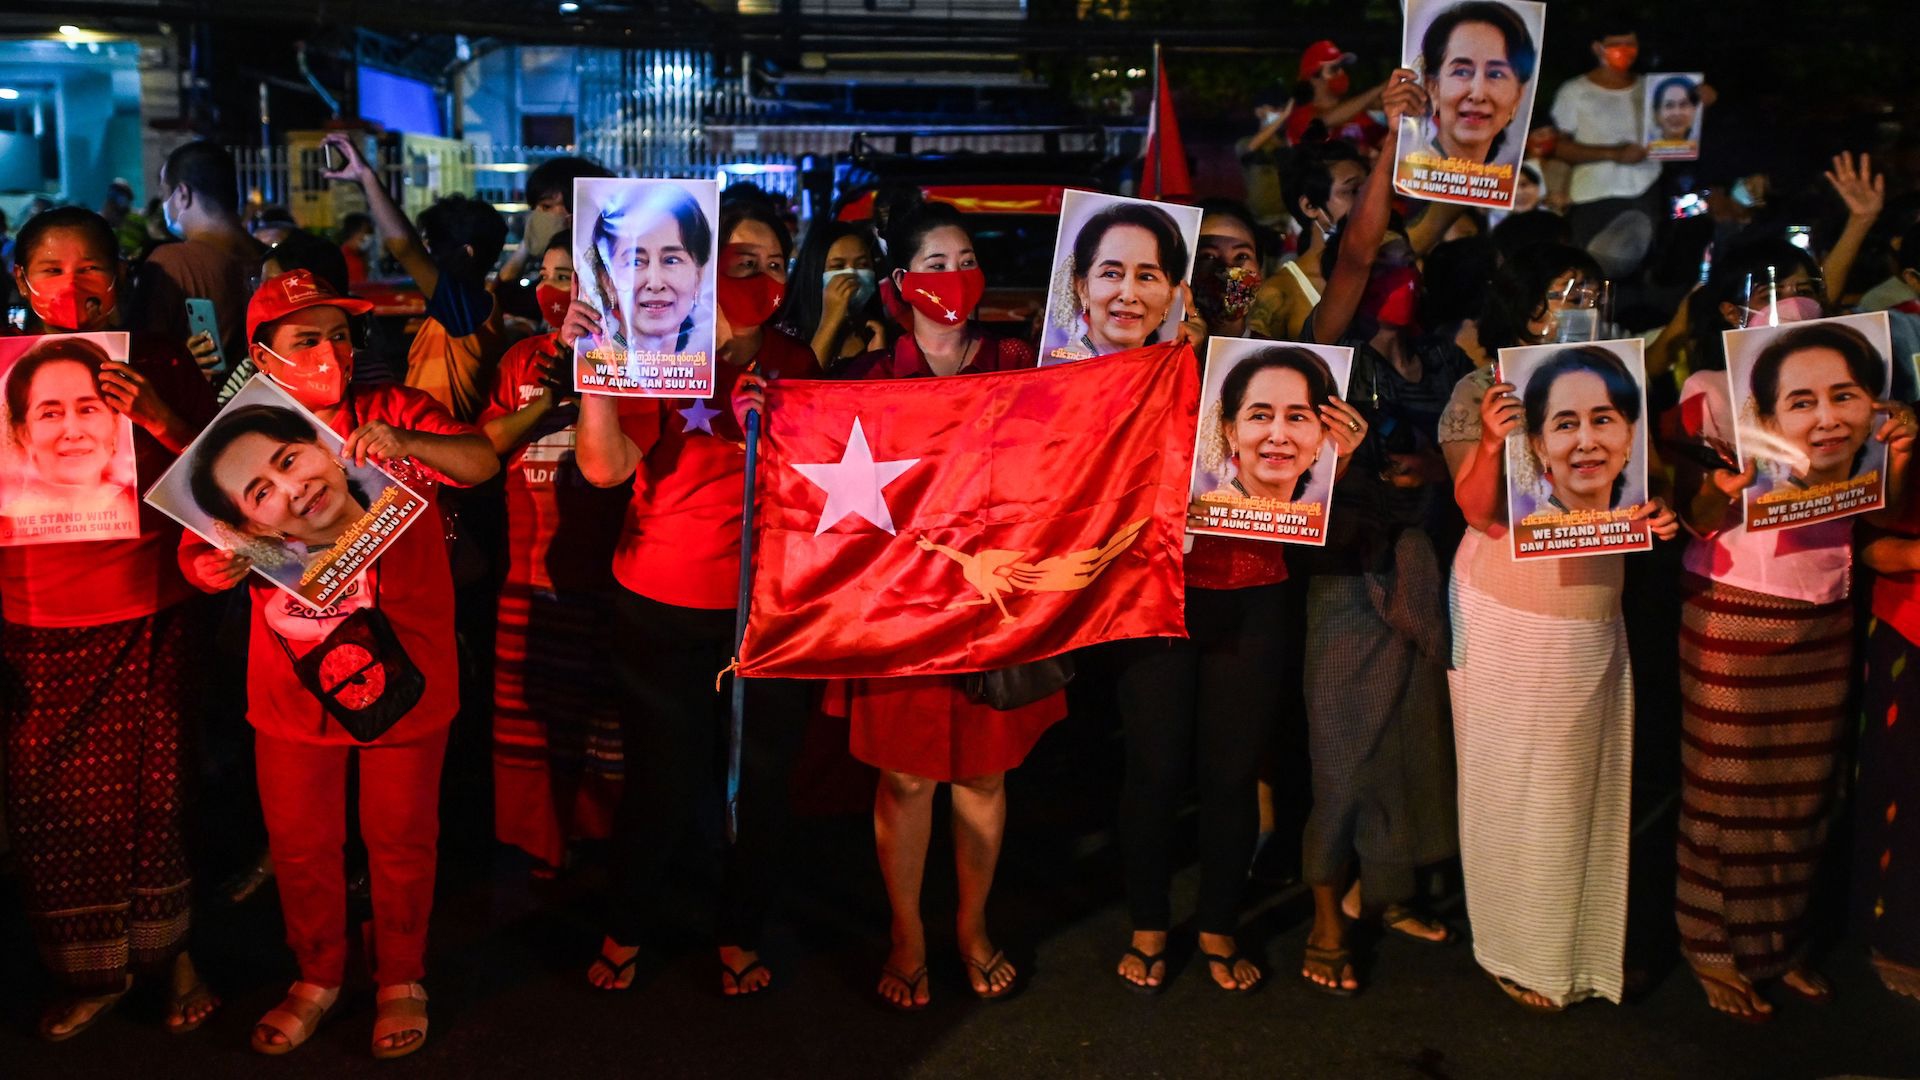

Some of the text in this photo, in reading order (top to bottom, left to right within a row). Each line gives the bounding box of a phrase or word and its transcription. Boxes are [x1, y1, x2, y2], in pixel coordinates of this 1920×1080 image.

[1413, 168, 1499, 189] WE STAND WITH
[1422, 182, 1447, 193] AUNG
[1448, 185, 1468, 196] SAN
[1471, 187, 1490, 198] SUU
[1491, 190, 1509, 200] KYI
[596, 364, 614, 376] WE
[663, 367, 694, 378] WITH
[582, 375, 707, 389] DAW AUNG SAN SUU KYI
[1753, 494, 1878, 527] DAW AUNG SAN SUU KYI
[1768, 505, 1787, 516] WE
[1791, 496, 1832, 511] STAND
[1835, 487, 1866, 502] WITH
[17, 510, 118, 525] WE STAND WITH
[1209, 506, 1307, 526] WE STAND WITH
[65, 523, 87, 533] SAN
[90, 522, 111, 532] SUU
[114, 520, 132, 530] KYI
[1222, 520, 1250, 530] AUNG
[1253, 522, 1275, 532] SAN
[1277, 525, 1298, 535] SUU
[1300, 527, 1319, 537] KYI
[1533, 522, 1630, 540] WE STAND WITH
[317, 567, 338, 585] WE
[335, 533, 372, 569] STAND
[369, 504, 399, 533] WITH
[317, 580, 340, 602] DAW
[338, 555, 365, 581] AUNG
[362, 536, 383, 555] SAN
[381, 517, 401, 537] SUU
[398, 500, 417, 519] KYI
[1520, 533, 1644, 552] DAW AUNG SAN SUU KYI
